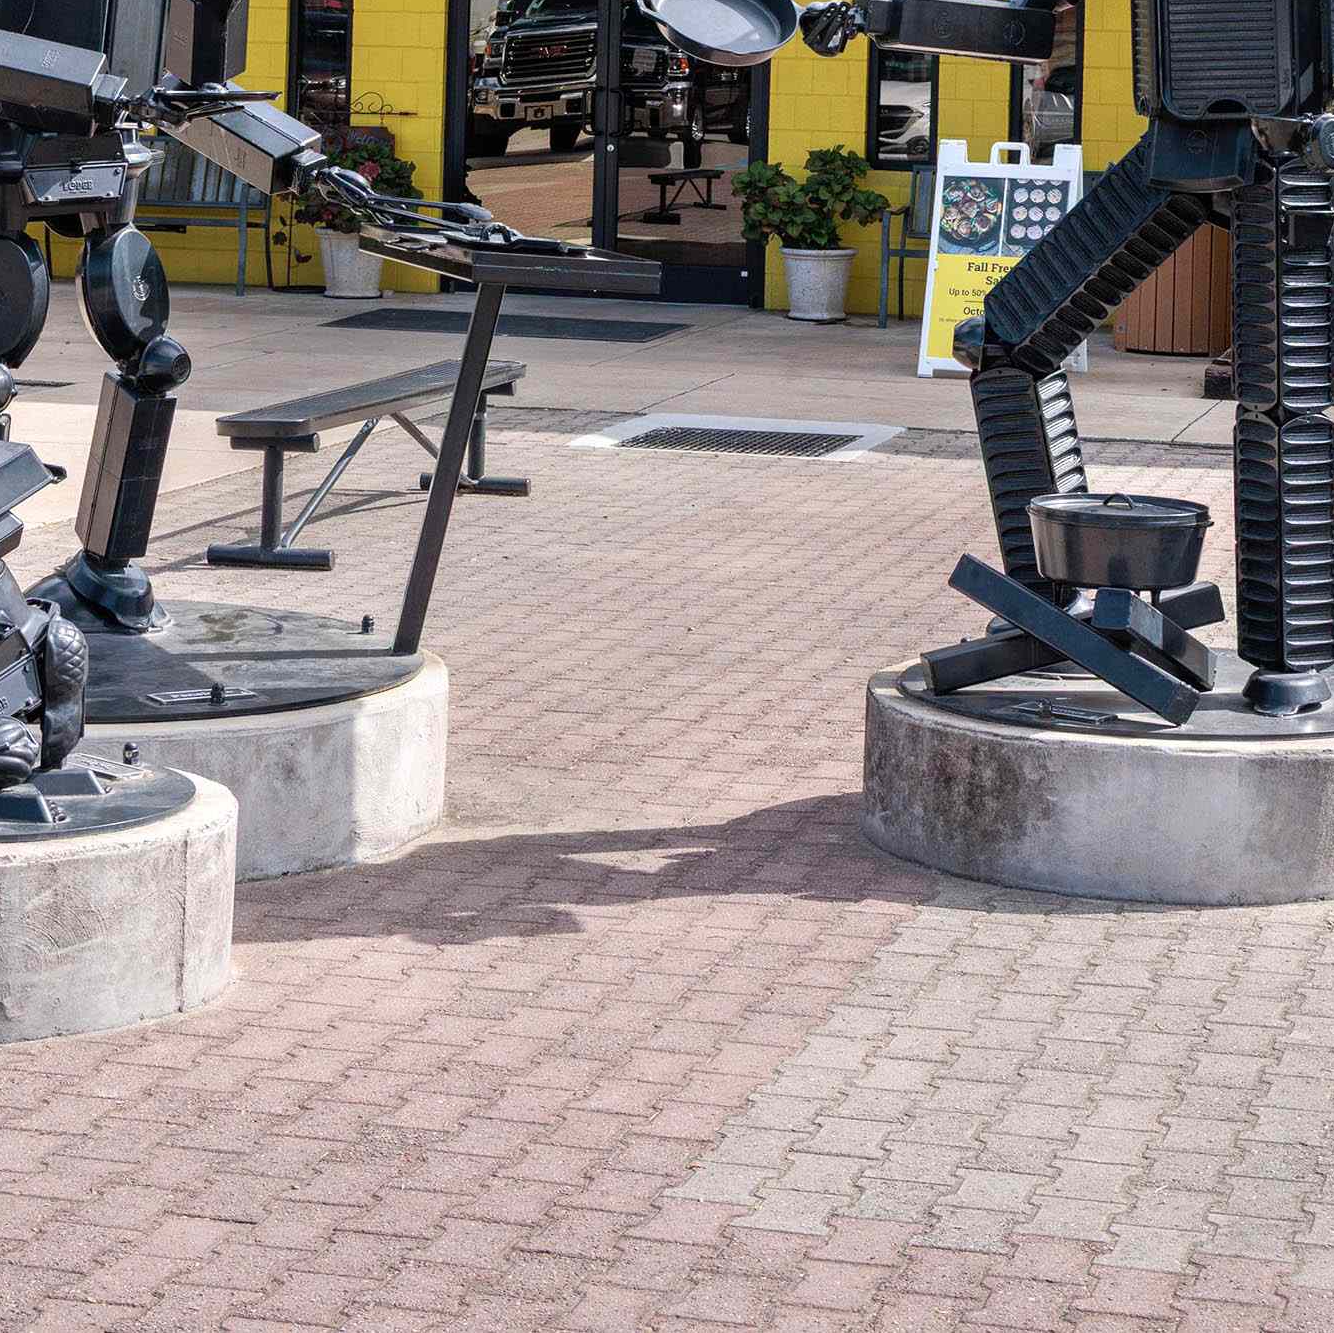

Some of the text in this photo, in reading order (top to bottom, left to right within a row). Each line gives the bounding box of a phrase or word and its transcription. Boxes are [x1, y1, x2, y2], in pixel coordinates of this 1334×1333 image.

[967, 262, 1013, 273] Fall Fre
[949, 287, 959, 296] Up
